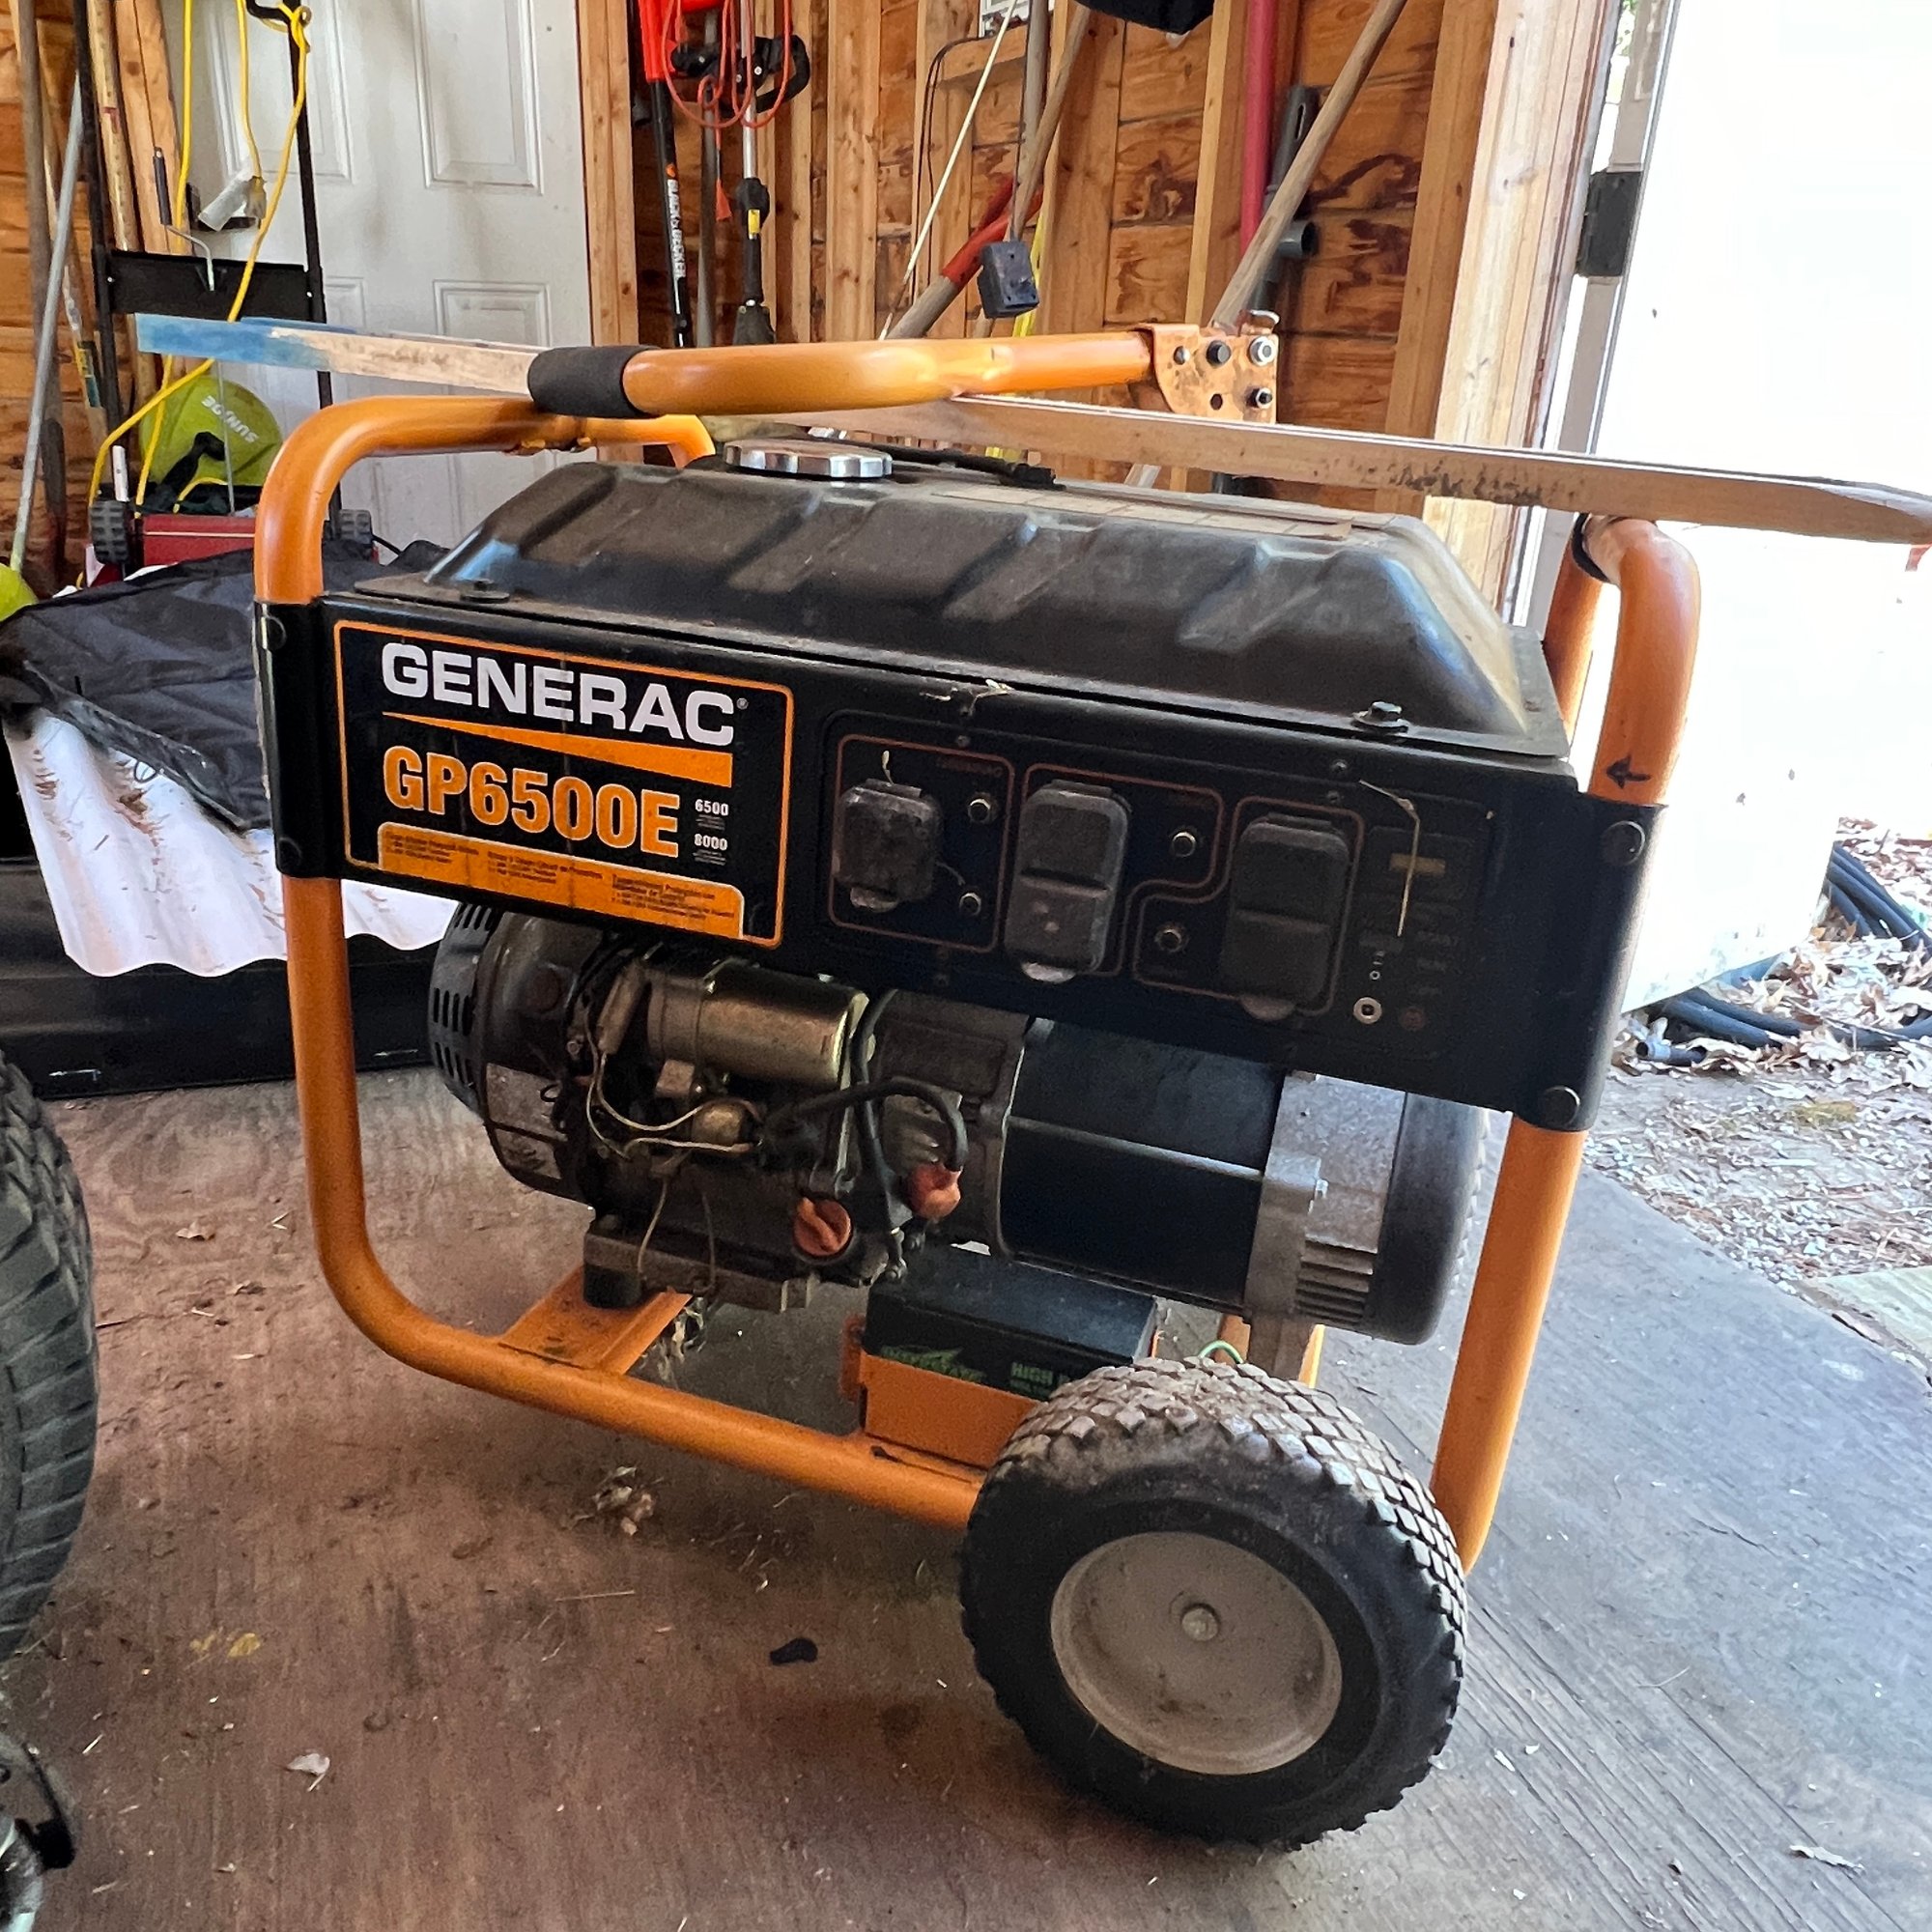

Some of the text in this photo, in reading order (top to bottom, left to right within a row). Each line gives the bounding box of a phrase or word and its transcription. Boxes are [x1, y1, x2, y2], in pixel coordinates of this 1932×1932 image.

[382, 641, 734, 747] GENERAC
[383, 745, 680, 858] GP6500E
[695, 798, 729, 816] 6500
[694, 833, 728, 851] 8000
[1010, 1362, 1054, 1385] HIGH
